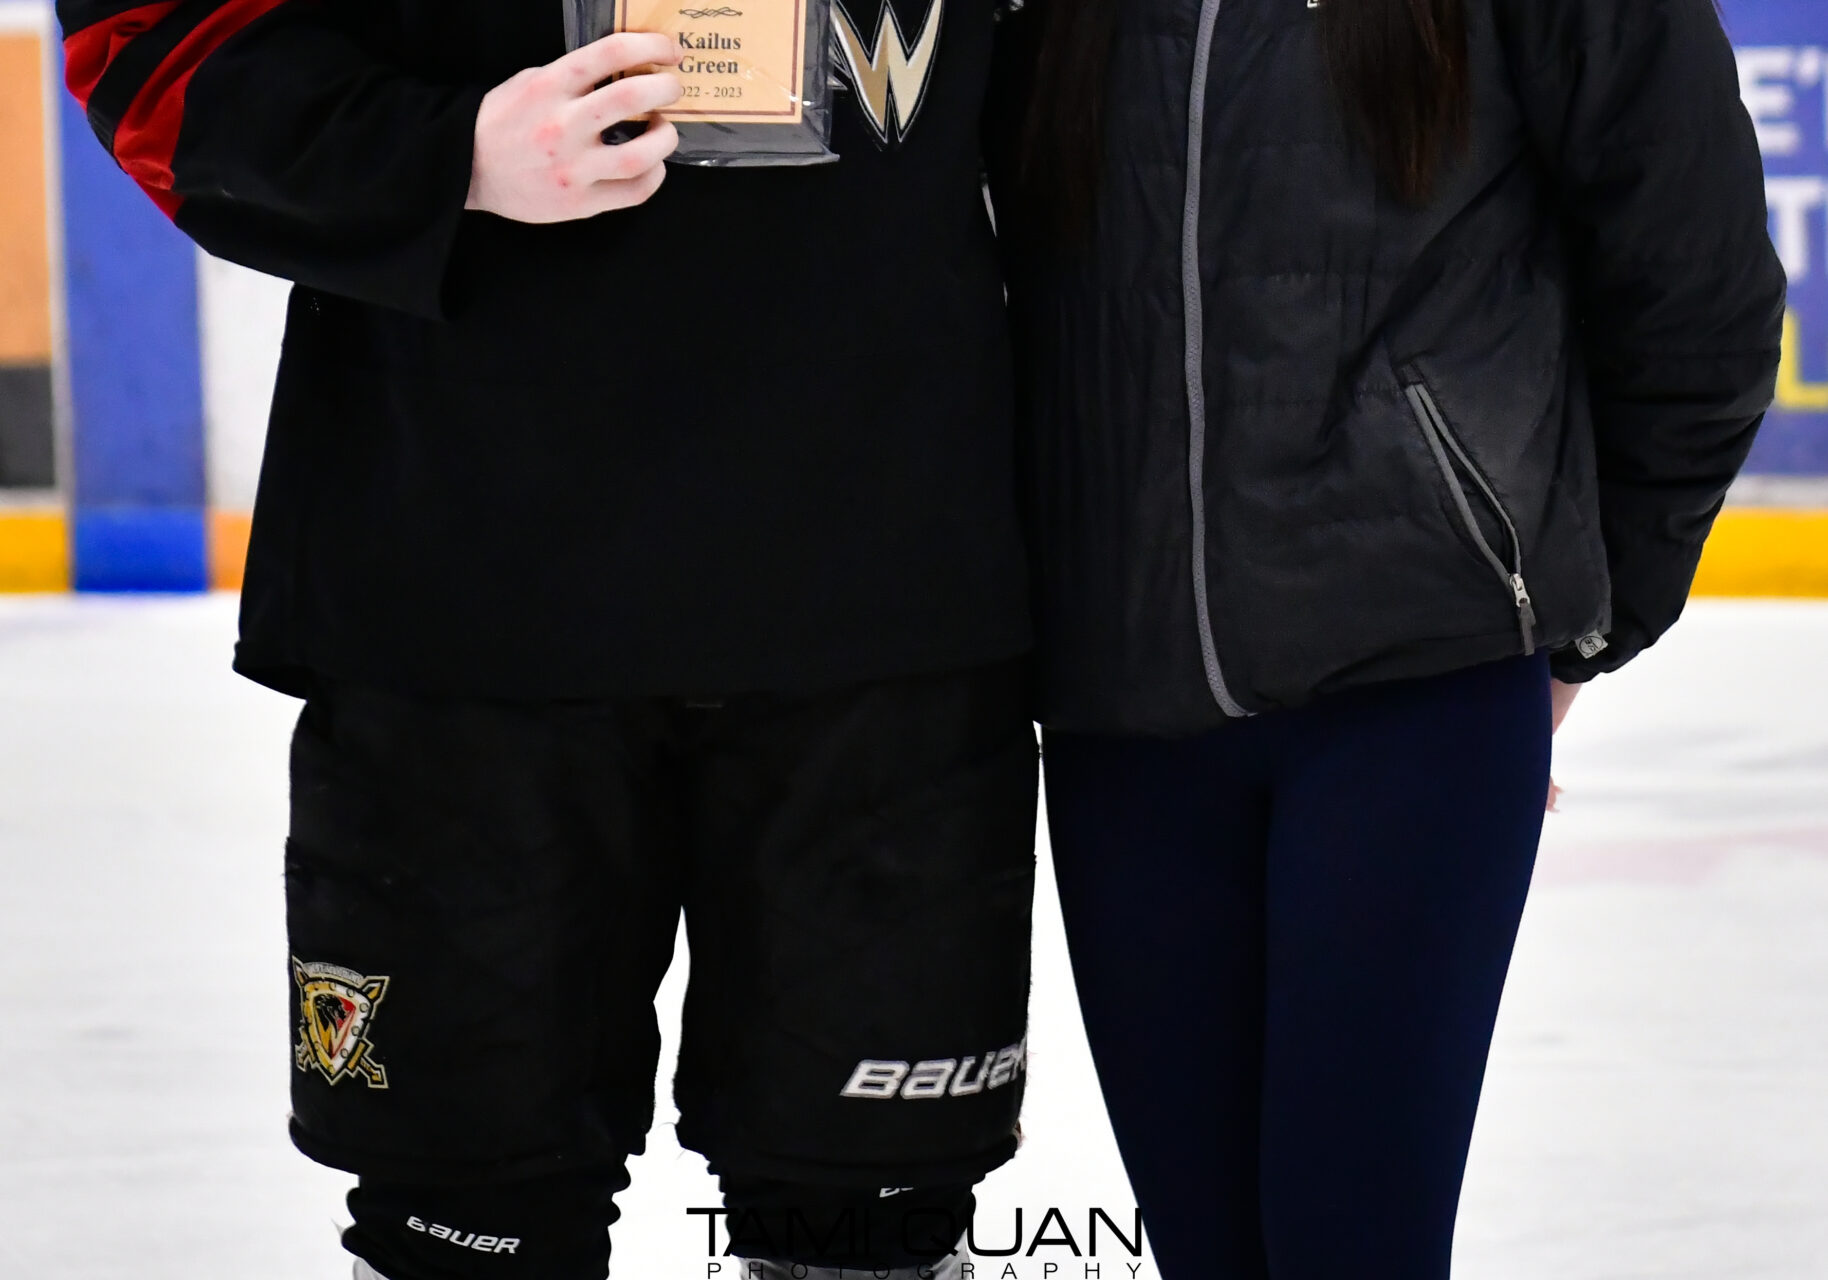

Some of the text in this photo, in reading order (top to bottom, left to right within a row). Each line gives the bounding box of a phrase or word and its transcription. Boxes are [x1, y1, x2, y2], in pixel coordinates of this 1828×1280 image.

[678, 31, 742, 50] Kailus
[678, 55, 738, 74] Green
[681, 86, 700, 97] 022
[714, 86, 742, 97] 2023
